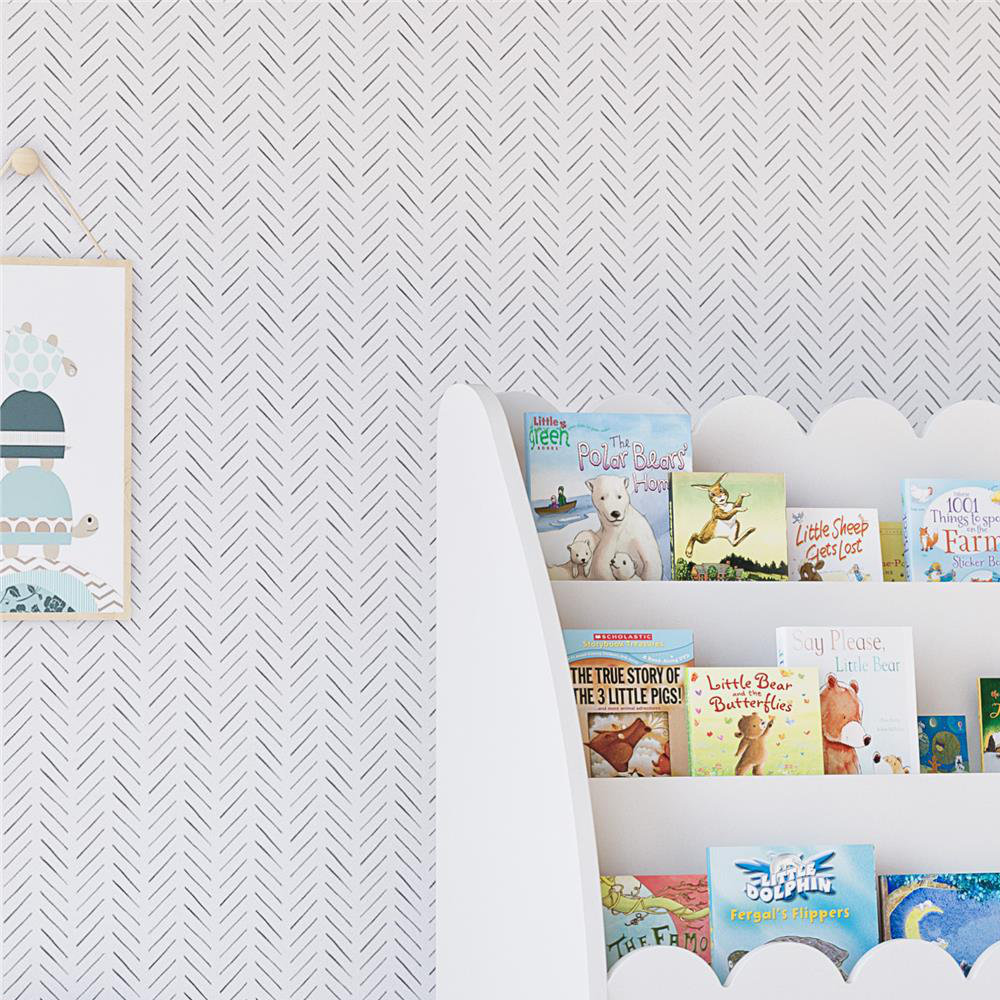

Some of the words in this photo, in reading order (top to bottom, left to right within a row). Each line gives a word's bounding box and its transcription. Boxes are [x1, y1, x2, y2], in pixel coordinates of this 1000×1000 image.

[533, 415, 559, 427] Little
[528, 426, 571, 450] green
[609, 434, 632, 449] The
[576, 441, 629, 472] Polar
[632, 472, 670, 494] Hom
[946, 496, 980, 514] 1001
[929, 508, 969, 528] Things
[971, 511, 982, 527] to
[795, 519, 830, 547] Little
[831, 513, 870, 541] Sheep
[805, 542, 838, 562] Gets
[838, 537, 864, 561] Lost
[952, 555, 986, 568] Sticker
[791, 630, 824, 657] Say
[830, 629, 886, 652] Please,
[835, 655, 869, 673] Little
[872, 655, 901, 673] Bear
[569, 666, 594, 684] THE
[594, 666, 625, 684] TRUE
[626, 666, 664, 684] STORY
[665, 666, 681, 684] OF
[706, 673, 752, 691] Little
[754, 672, 793, 691] Bear
[597, 687, 606, 705] 3
[608, 687, 649, 705] LITTLE
[650, 687, 683, 705] PIGS!
[708, 692, 793, 714] Butterflies
[748, 689, 762, 697] the
[760, 861, 817, 887] LITTLE
[745, 876, 834, 904] DOLPHIN
[730, 907, 788, 923] Fergal's
[791, 907, 850, 924] Flippers
[607, 932, 648, 960] THE
[650, 924, 708, 954] FAMO
